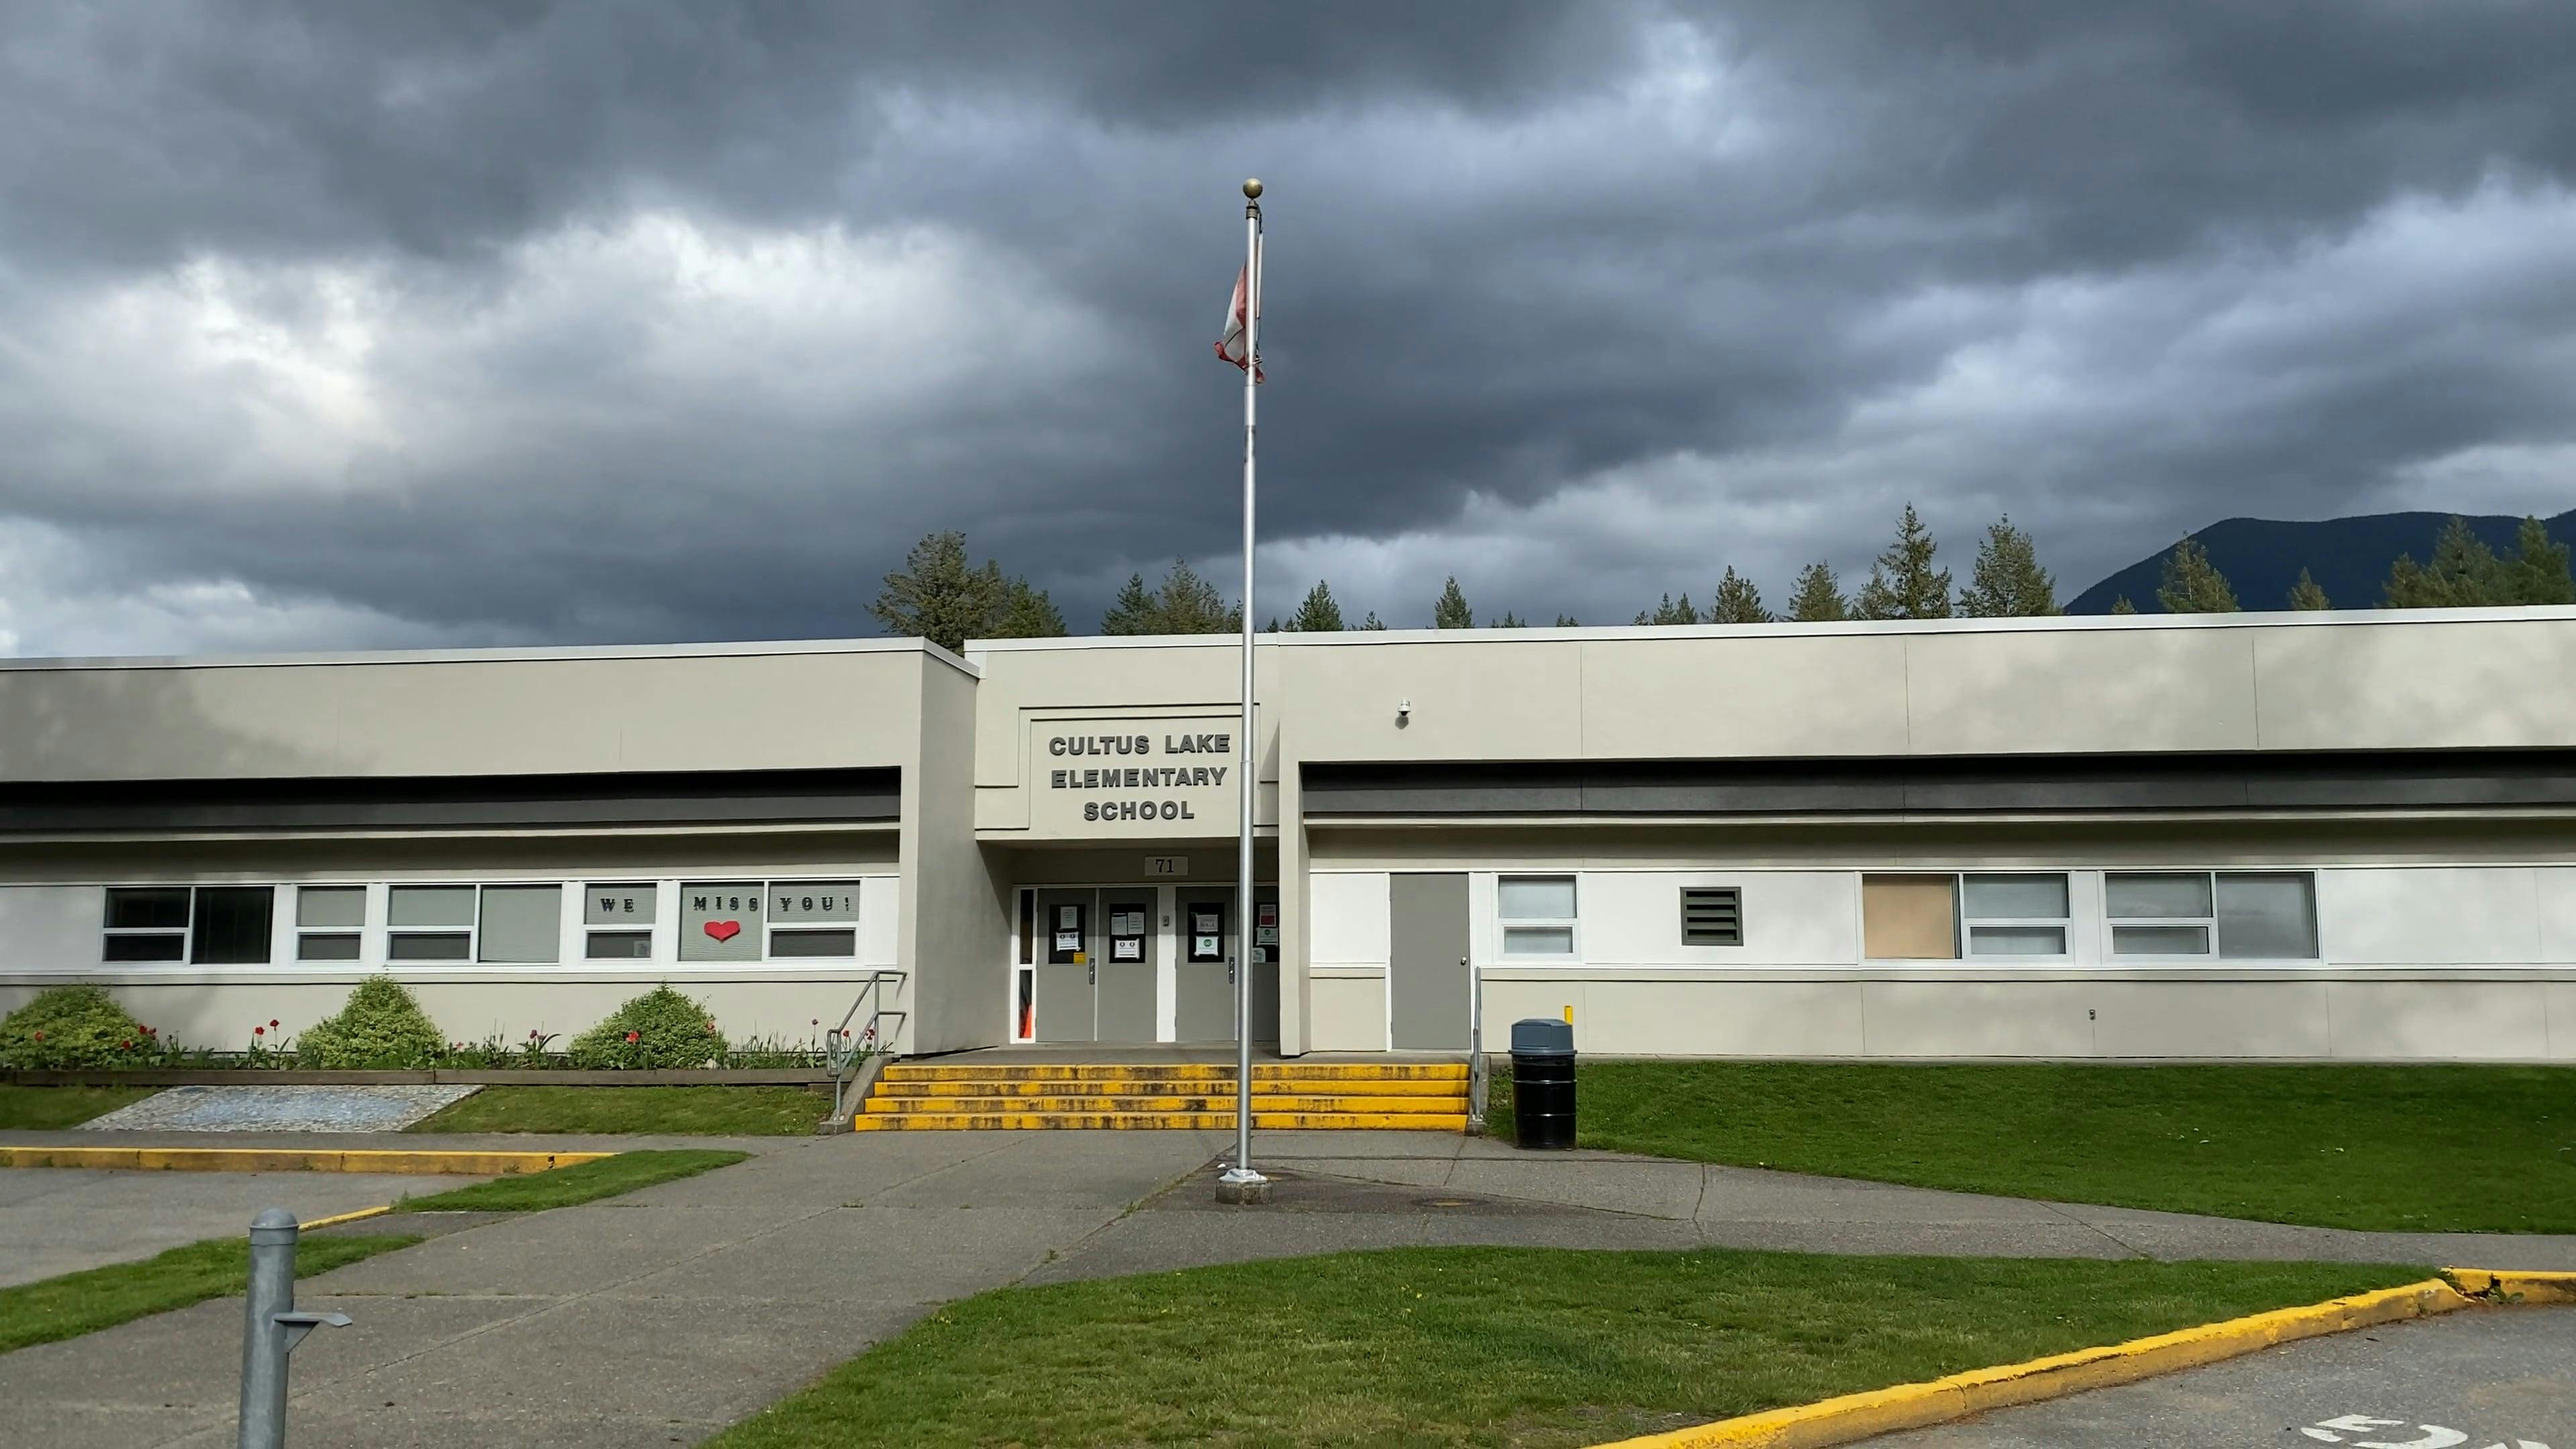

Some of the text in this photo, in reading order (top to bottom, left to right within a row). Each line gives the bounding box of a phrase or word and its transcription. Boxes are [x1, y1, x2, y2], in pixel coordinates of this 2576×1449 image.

[1049, 734, 1230, 756] CULTUS LAKE
[1051, 767, 1228, 789] ELEMENTARY
[1083, 800, 1195, 821] SCHOOL
[1155, 859, 1175, 873] 71
[600, 896, 849, 913] WE MISS YOU!
